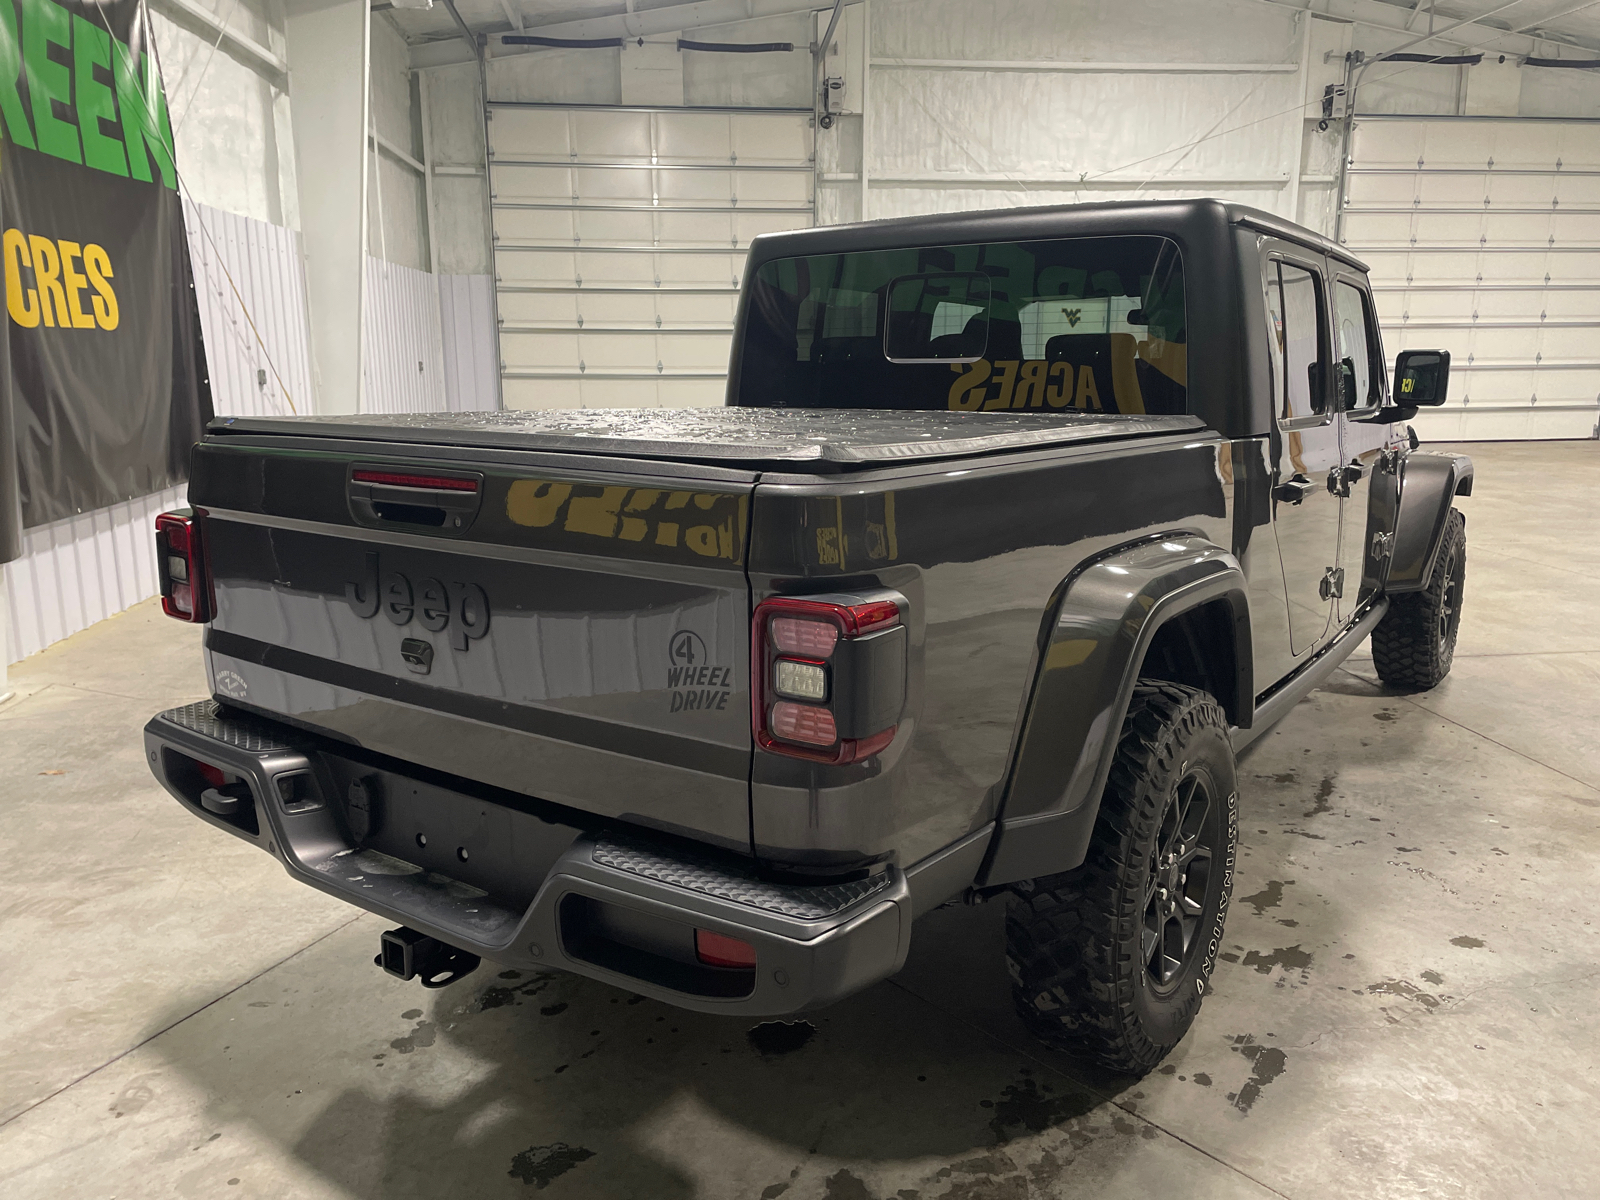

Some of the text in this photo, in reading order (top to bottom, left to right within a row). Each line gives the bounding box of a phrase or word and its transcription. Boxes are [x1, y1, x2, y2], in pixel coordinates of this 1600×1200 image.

[0, 0, 177, 190] REEN
[345, 551, 491, 652] Jeep
[667, 666, 730, 689] WHEEL
[675, 635, 695, 665] 4
[670, 689, 730, 713] DRIVE
[1202, 791, 1237, 978] DESTINATION
